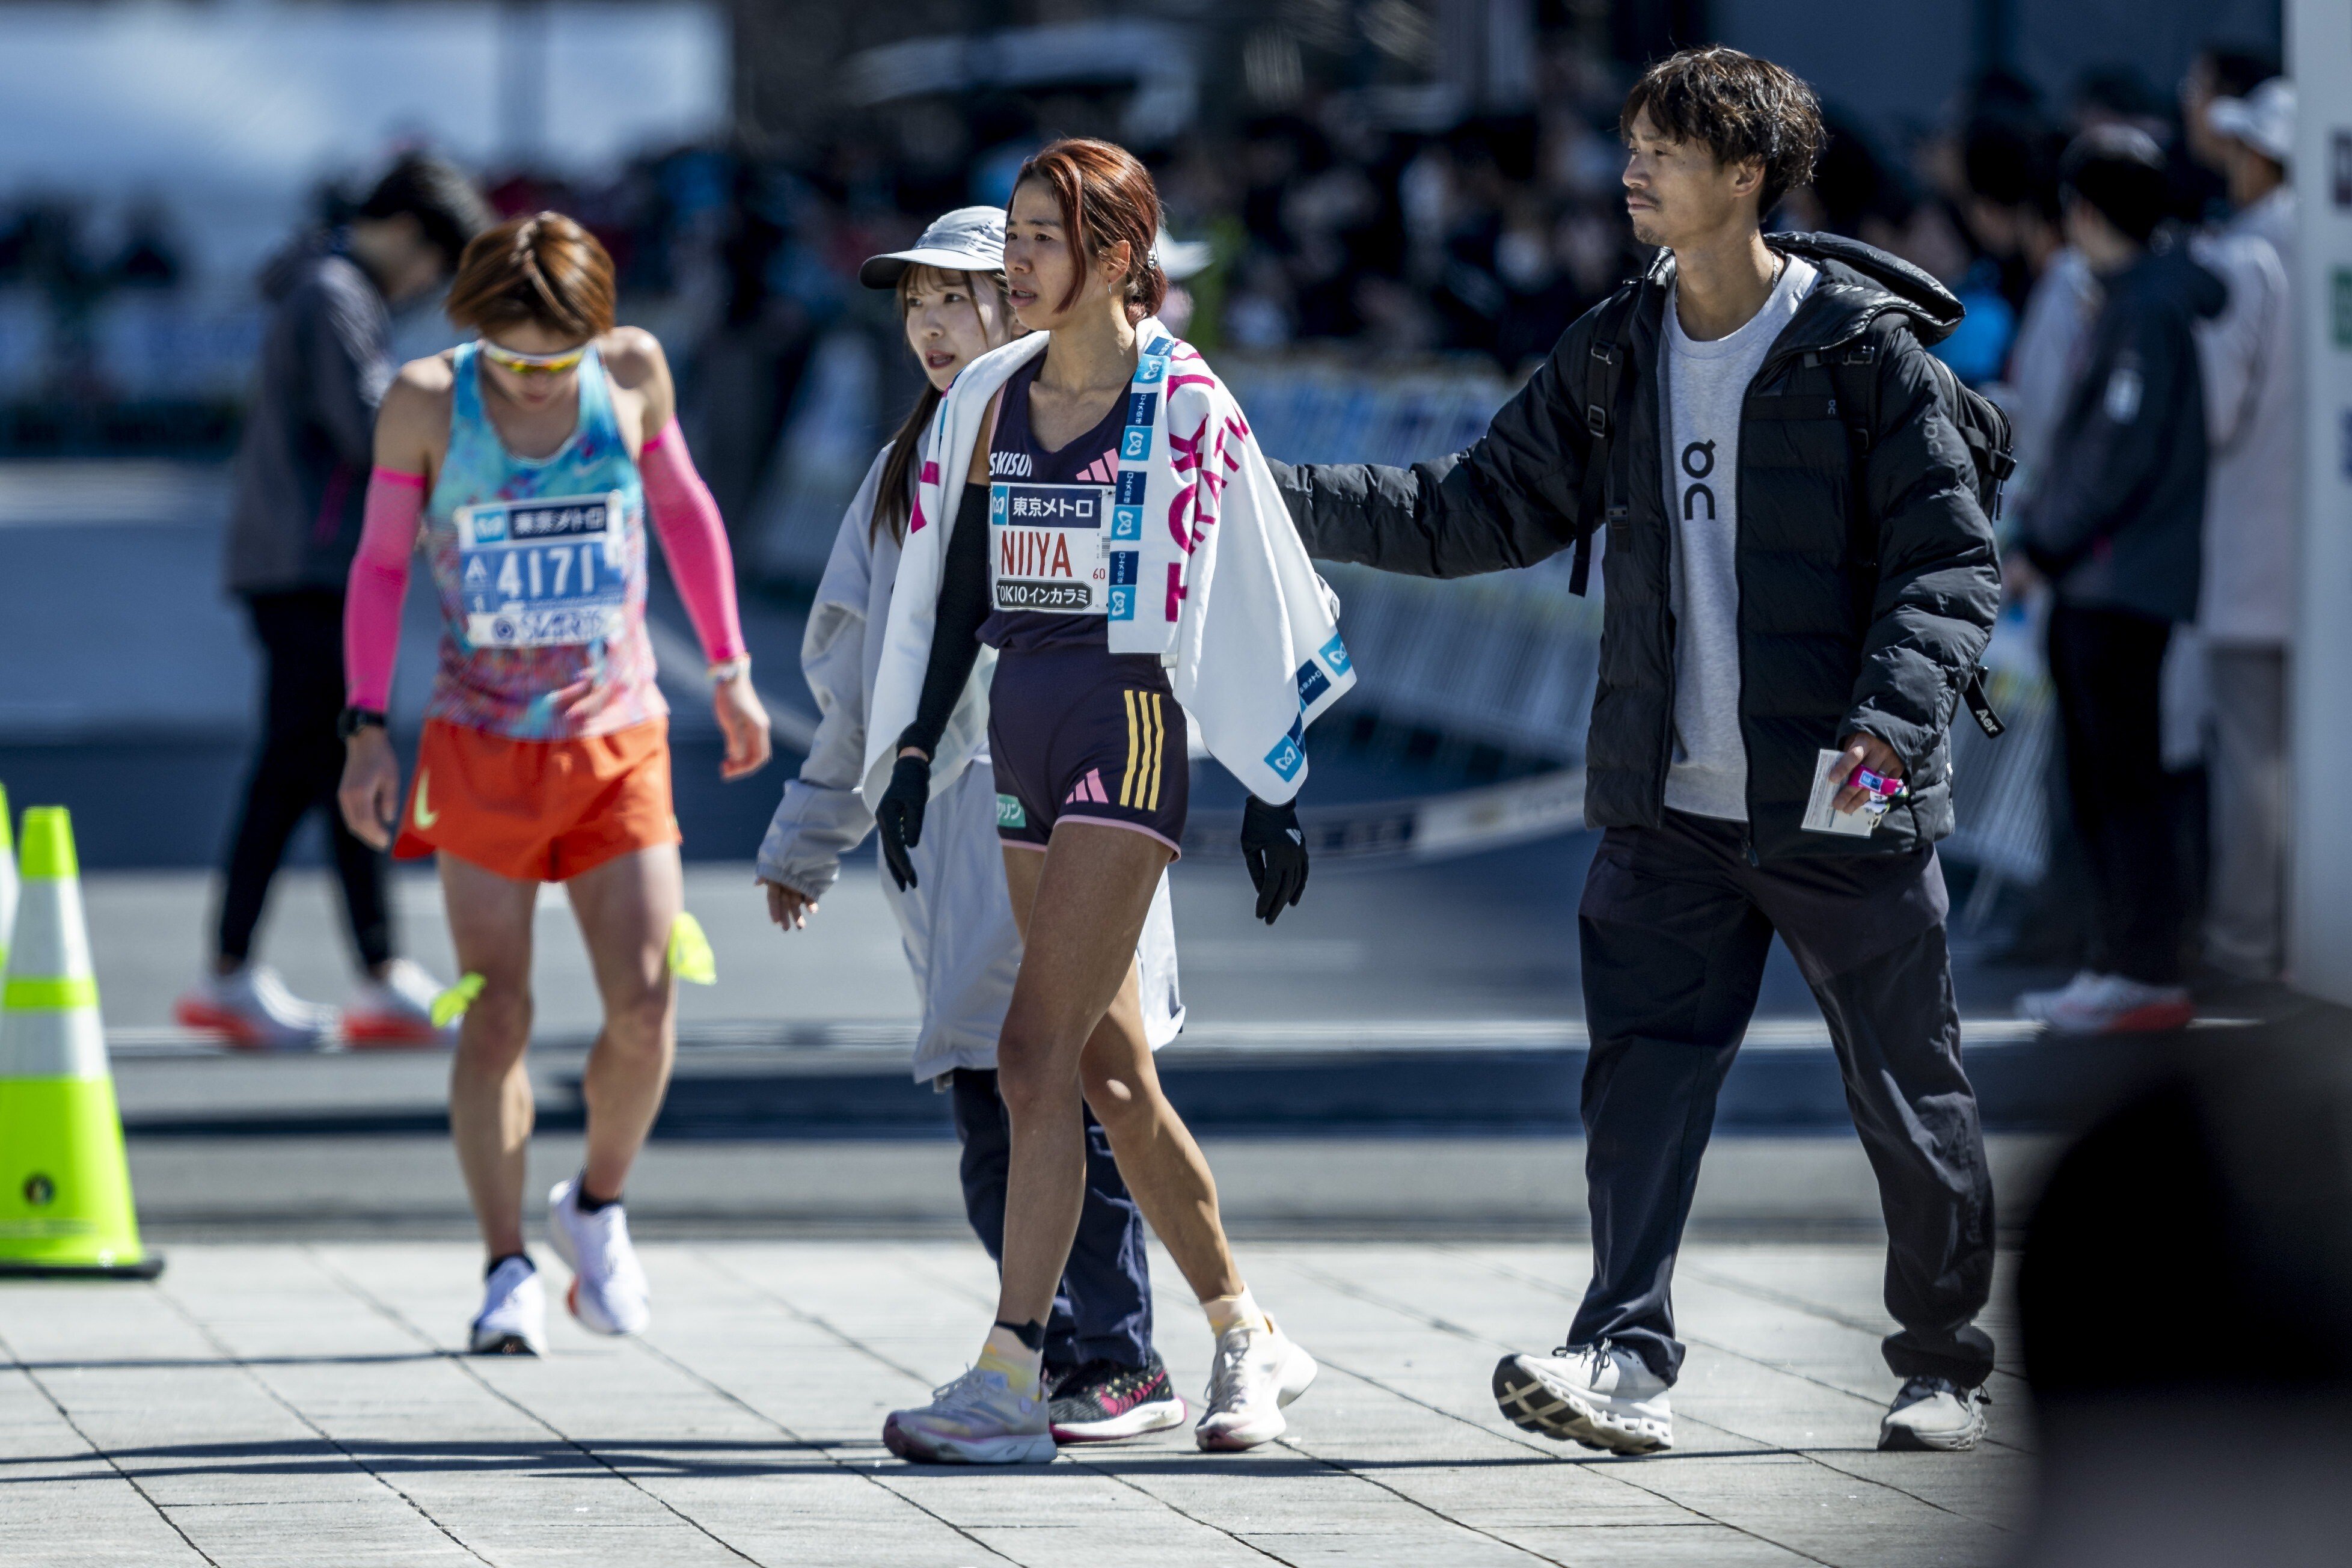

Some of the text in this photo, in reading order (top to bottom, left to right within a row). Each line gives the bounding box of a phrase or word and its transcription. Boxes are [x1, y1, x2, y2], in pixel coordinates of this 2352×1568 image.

[1012, 496, 1093, 518] 東京メトロ
[1001, 530, 1073, 577] NIIYA
[497, 545, 595, 598] 4171
[1092, 568, 1106, 580] 60
[1976, 709, 1998, 732] Aer
